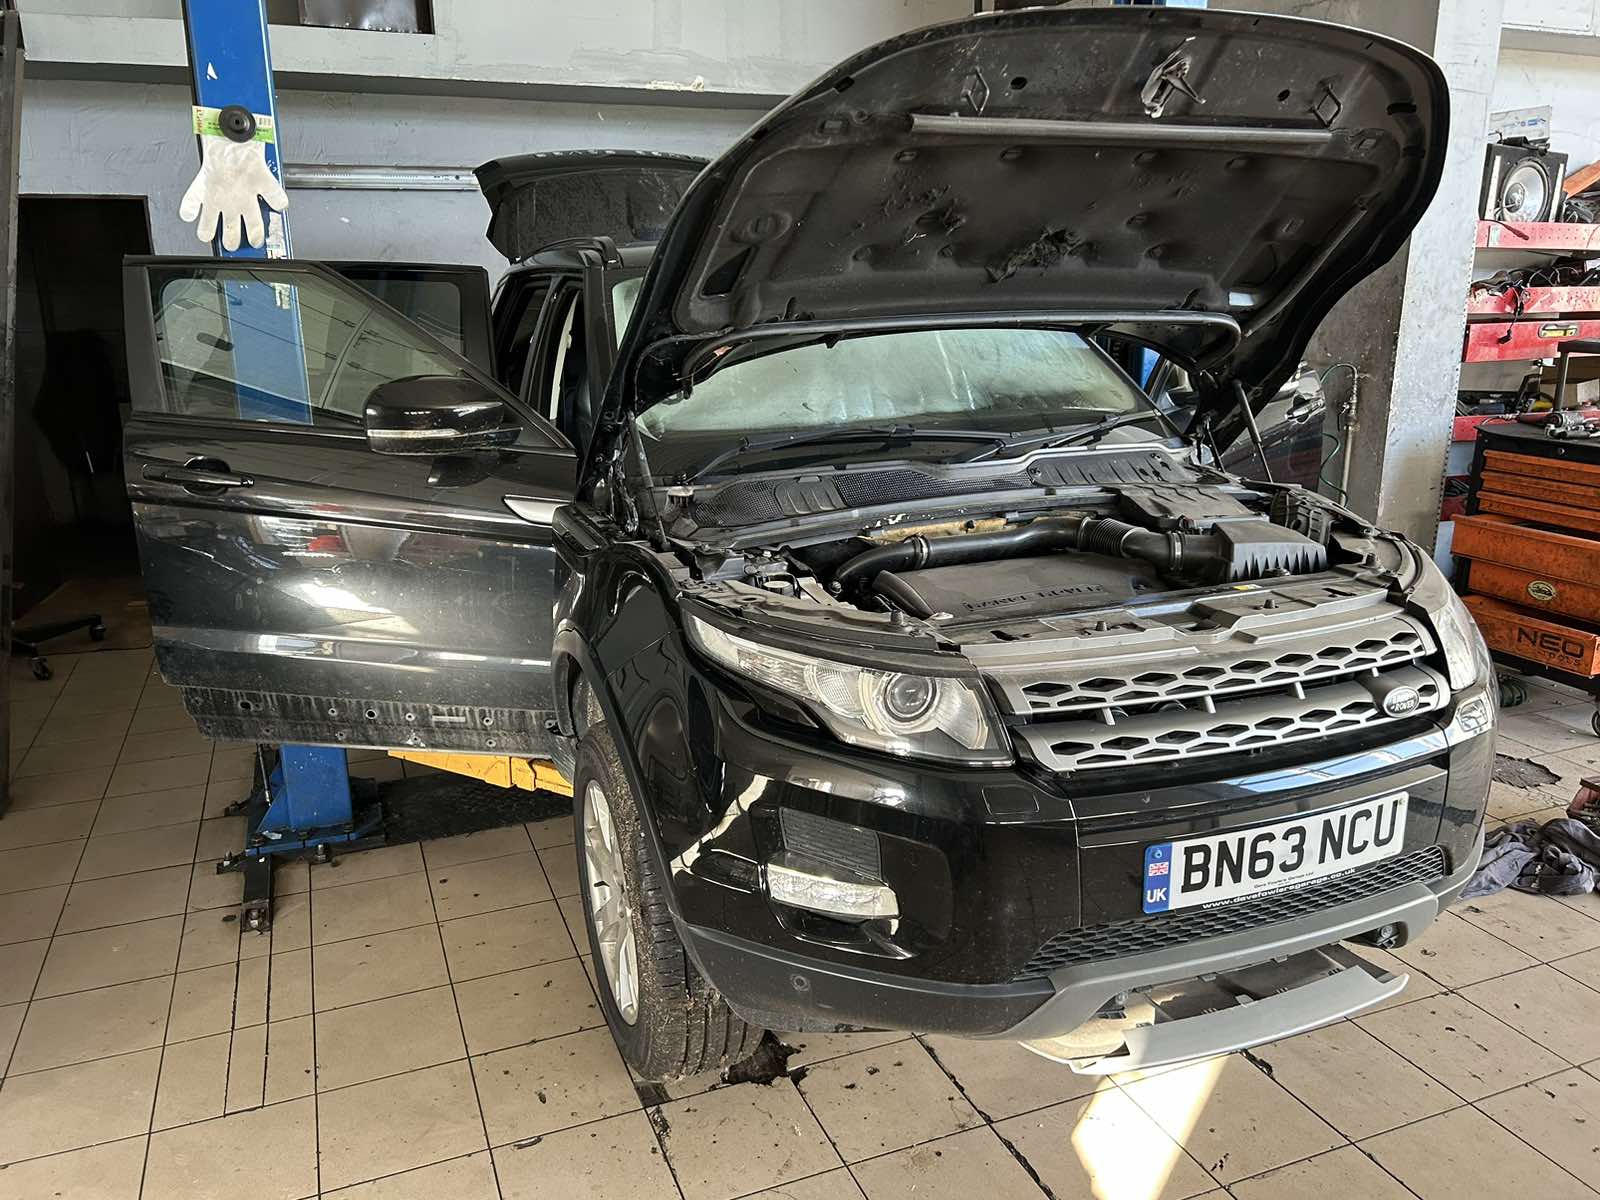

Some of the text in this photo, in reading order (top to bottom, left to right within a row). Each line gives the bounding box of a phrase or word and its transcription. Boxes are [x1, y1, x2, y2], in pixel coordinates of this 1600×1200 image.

[1517, 627, 1585, 658] NEO
[1181, 800, 1398, 893] BN63 NCU
[1146, 887, 1168, 904] UK
[1202, 868, 1356, 909] www.davefowlersgarage.co.uk
